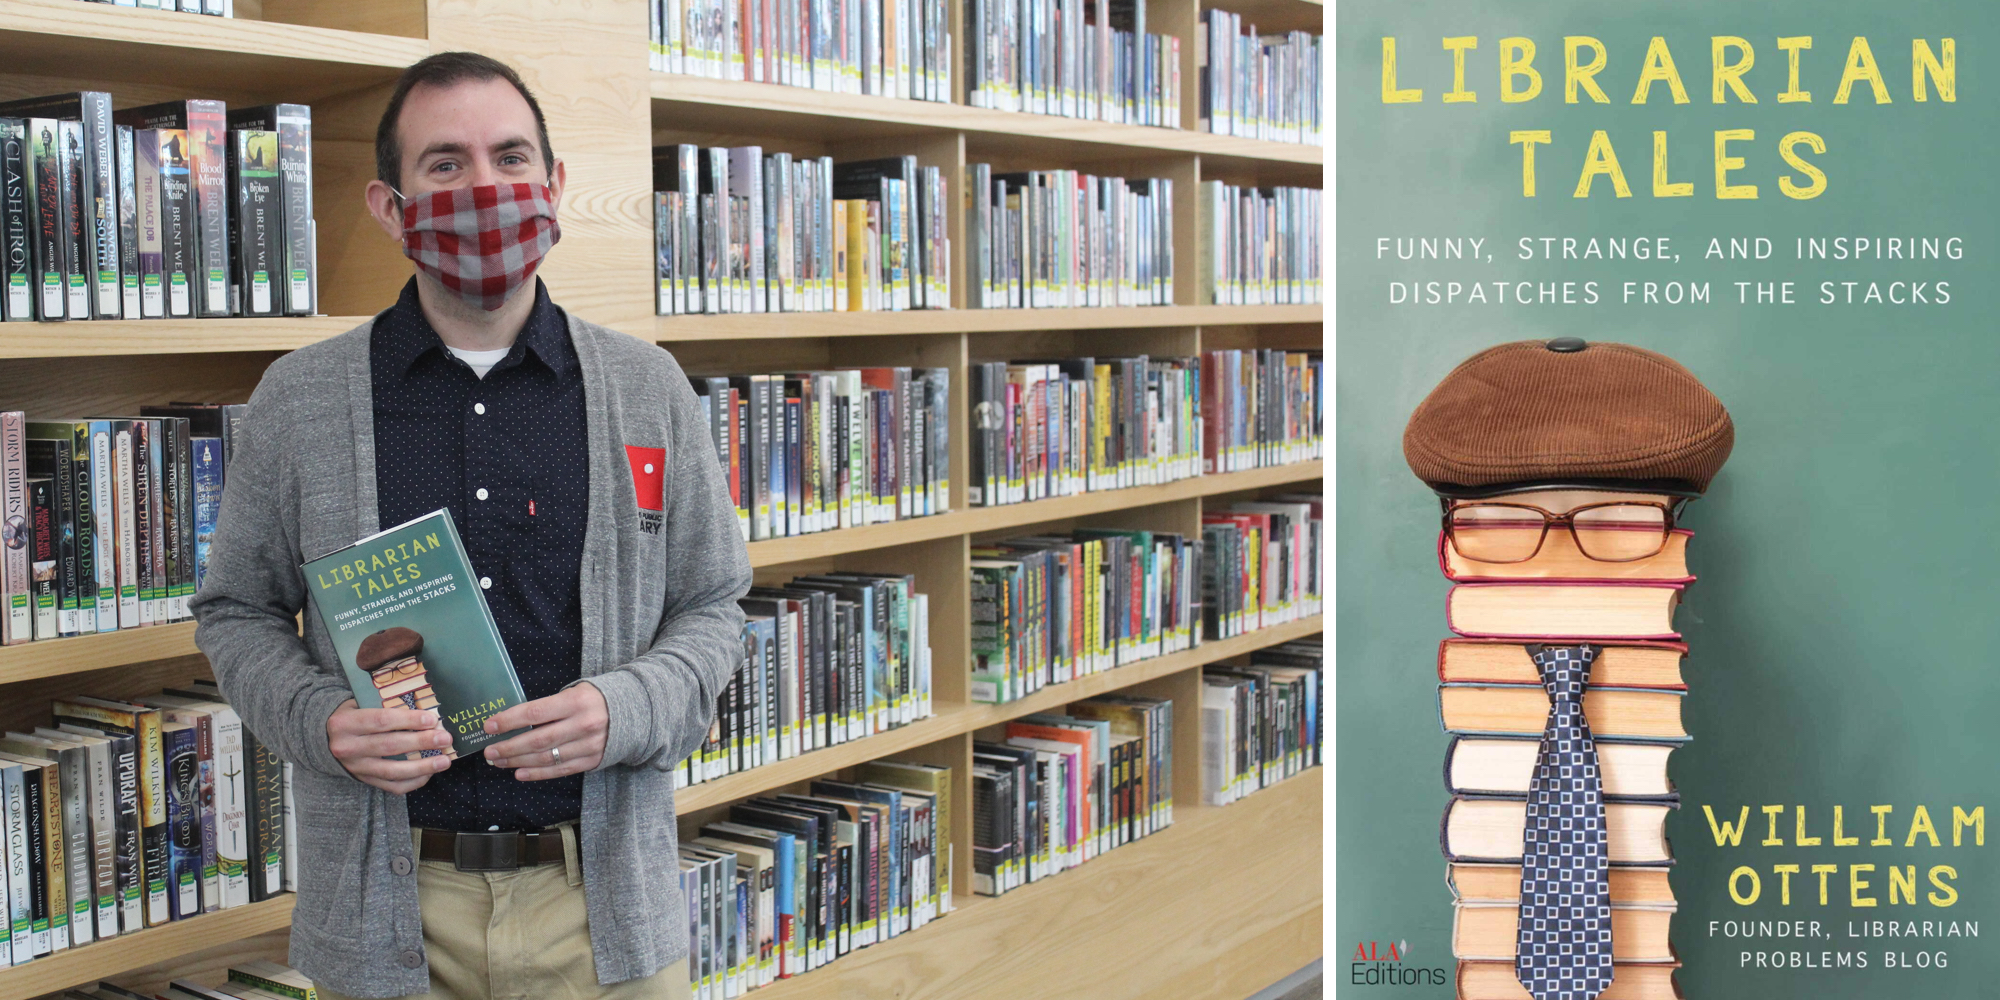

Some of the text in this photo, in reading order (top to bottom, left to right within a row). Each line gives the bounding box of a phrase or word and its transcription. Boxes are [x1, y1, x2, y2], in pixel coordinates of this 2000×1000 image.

[1381, 35, 1957, 105] LIBRARIAN
[97, 100, 107, 177] DAVID WEBER
[6, 141, 22, 213] CLASH
[200, 163, 222, 173] Blood
[1509, 129, 1828, 200] TALES
[145, 194, 154, 225] PALACE
[173, 206, 181, 247] BRENT
[207, 192, 219, 234] BRENT
[256, 209, 265, 248] BRENT
[292, 187, 305, 233] BRENT
[97, 219, 107, 266] SOUTH
[144, 226, 154, 241] JOB
[1377, 237, 1965, 263] FUNNY, STRANGE, AND INSPIRING
[1390, 281, 1952, 304] DISPATCHES FROM THE STACKS
[7, 419, 21, 513] STORM RIDERS
[60, 449, 71, 512] WORLDSHAPER
[99, 440, 107, 479] MARTHA
[78, 471, 90, 523] CLOUD
[100, 481, 108, 508] WELLS
[137, 464, 148, 505] SIREN
[65, 557, 75, 587] EDWARD
[80, 527, 92, 577] ROADS
[318, 532, 441, 589] LIBRARIAN
[351, 563, 422, 599] TALES
[398, 588, 414, 599] AND
[414, 574, 454, 593] INSPIRING
[339, 583, 457, 631] DISPATCHES FROM THE STACKS
[766, 646, 774, 726] GAMECHANGE
[448, 697, 506, 724] WILLIAM
[119, 752, 138, 815] UPDRAFT
[149, 727, 161, 815] KIM WILKINS
[256, 744, 267, 796] MPIRE
[10, 784, 24, 876] STORMGLASS
[31, 783, 41, 864] DRAGONSHADOW
[49, 770, 62, 873] HEARTSTONE
[1702, 803, 1986, 847] WILLIAM
[72, 833, 88, 900] CLOUDBOUN
[97, 830, 112, 887] HORIZON
[126, 830, 136, 861] FRAN
[204, 822, 214, 867] WORLDS
[1729, 864, 1959, 907] OTTENS
[1352, 942, 1400, 961] ALA
[1709, 920, 1980, 941] FOUNDER, LIBRARIAN
[1352, 962, 1446, 985] Editions
[1741, 951, 1949, 969] PROBLEMS BLOG
